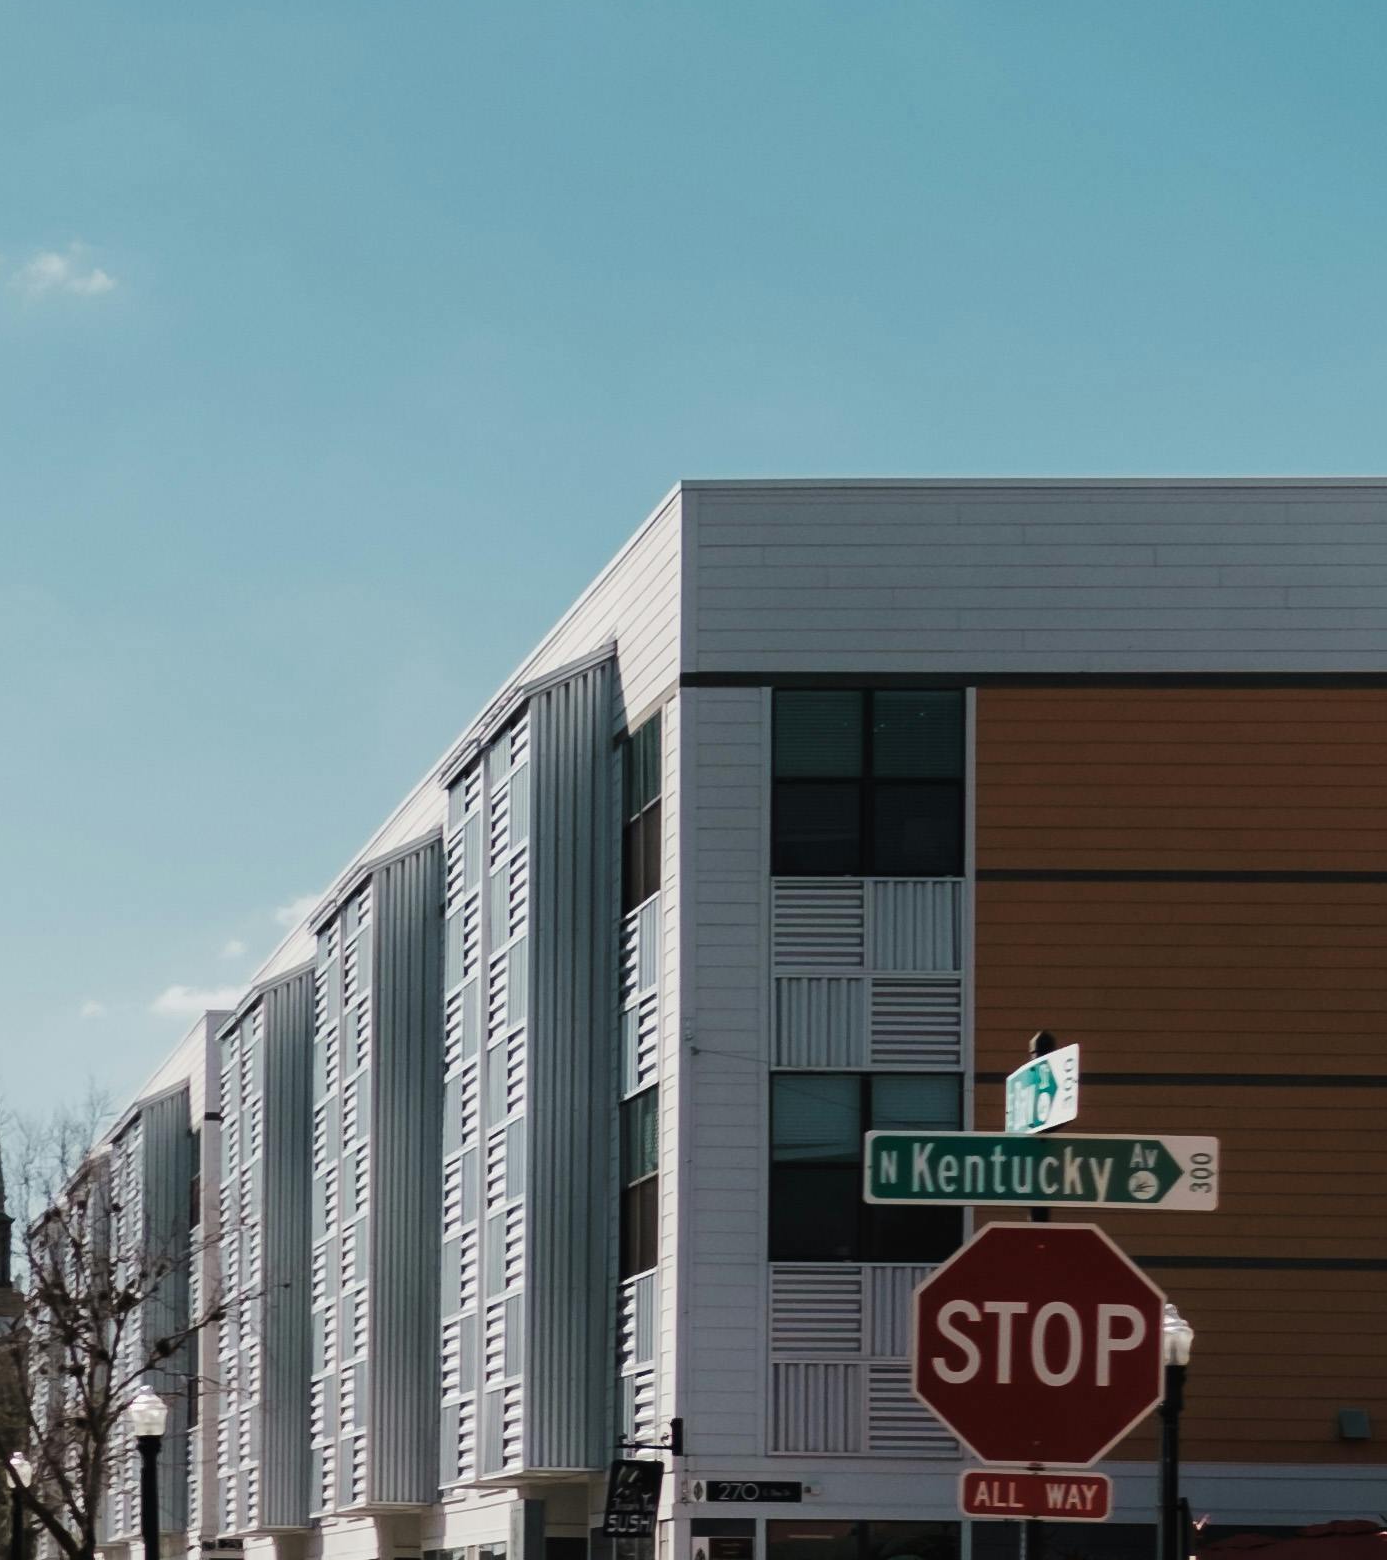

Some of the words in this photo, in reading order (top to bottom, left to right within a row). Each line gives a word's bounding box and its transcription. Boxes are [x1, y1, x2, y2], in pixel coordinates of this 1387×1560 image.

[880, 1149, 898, 1185] N
[911, 1142, 1115, 1203] Kentucky
[1129, 1143, 1159, 1169] Av
[1189, 1152, 1213, 1195] 300
[931, 1299, 1147, 1387] STOP
[718, 1482, 760, 1501] 270
[973, 1480, 1025, 1508] ALL
[1044, 1482, 1099, 1511] WAY
[606, 1514, 655, 1533] SUSHI
